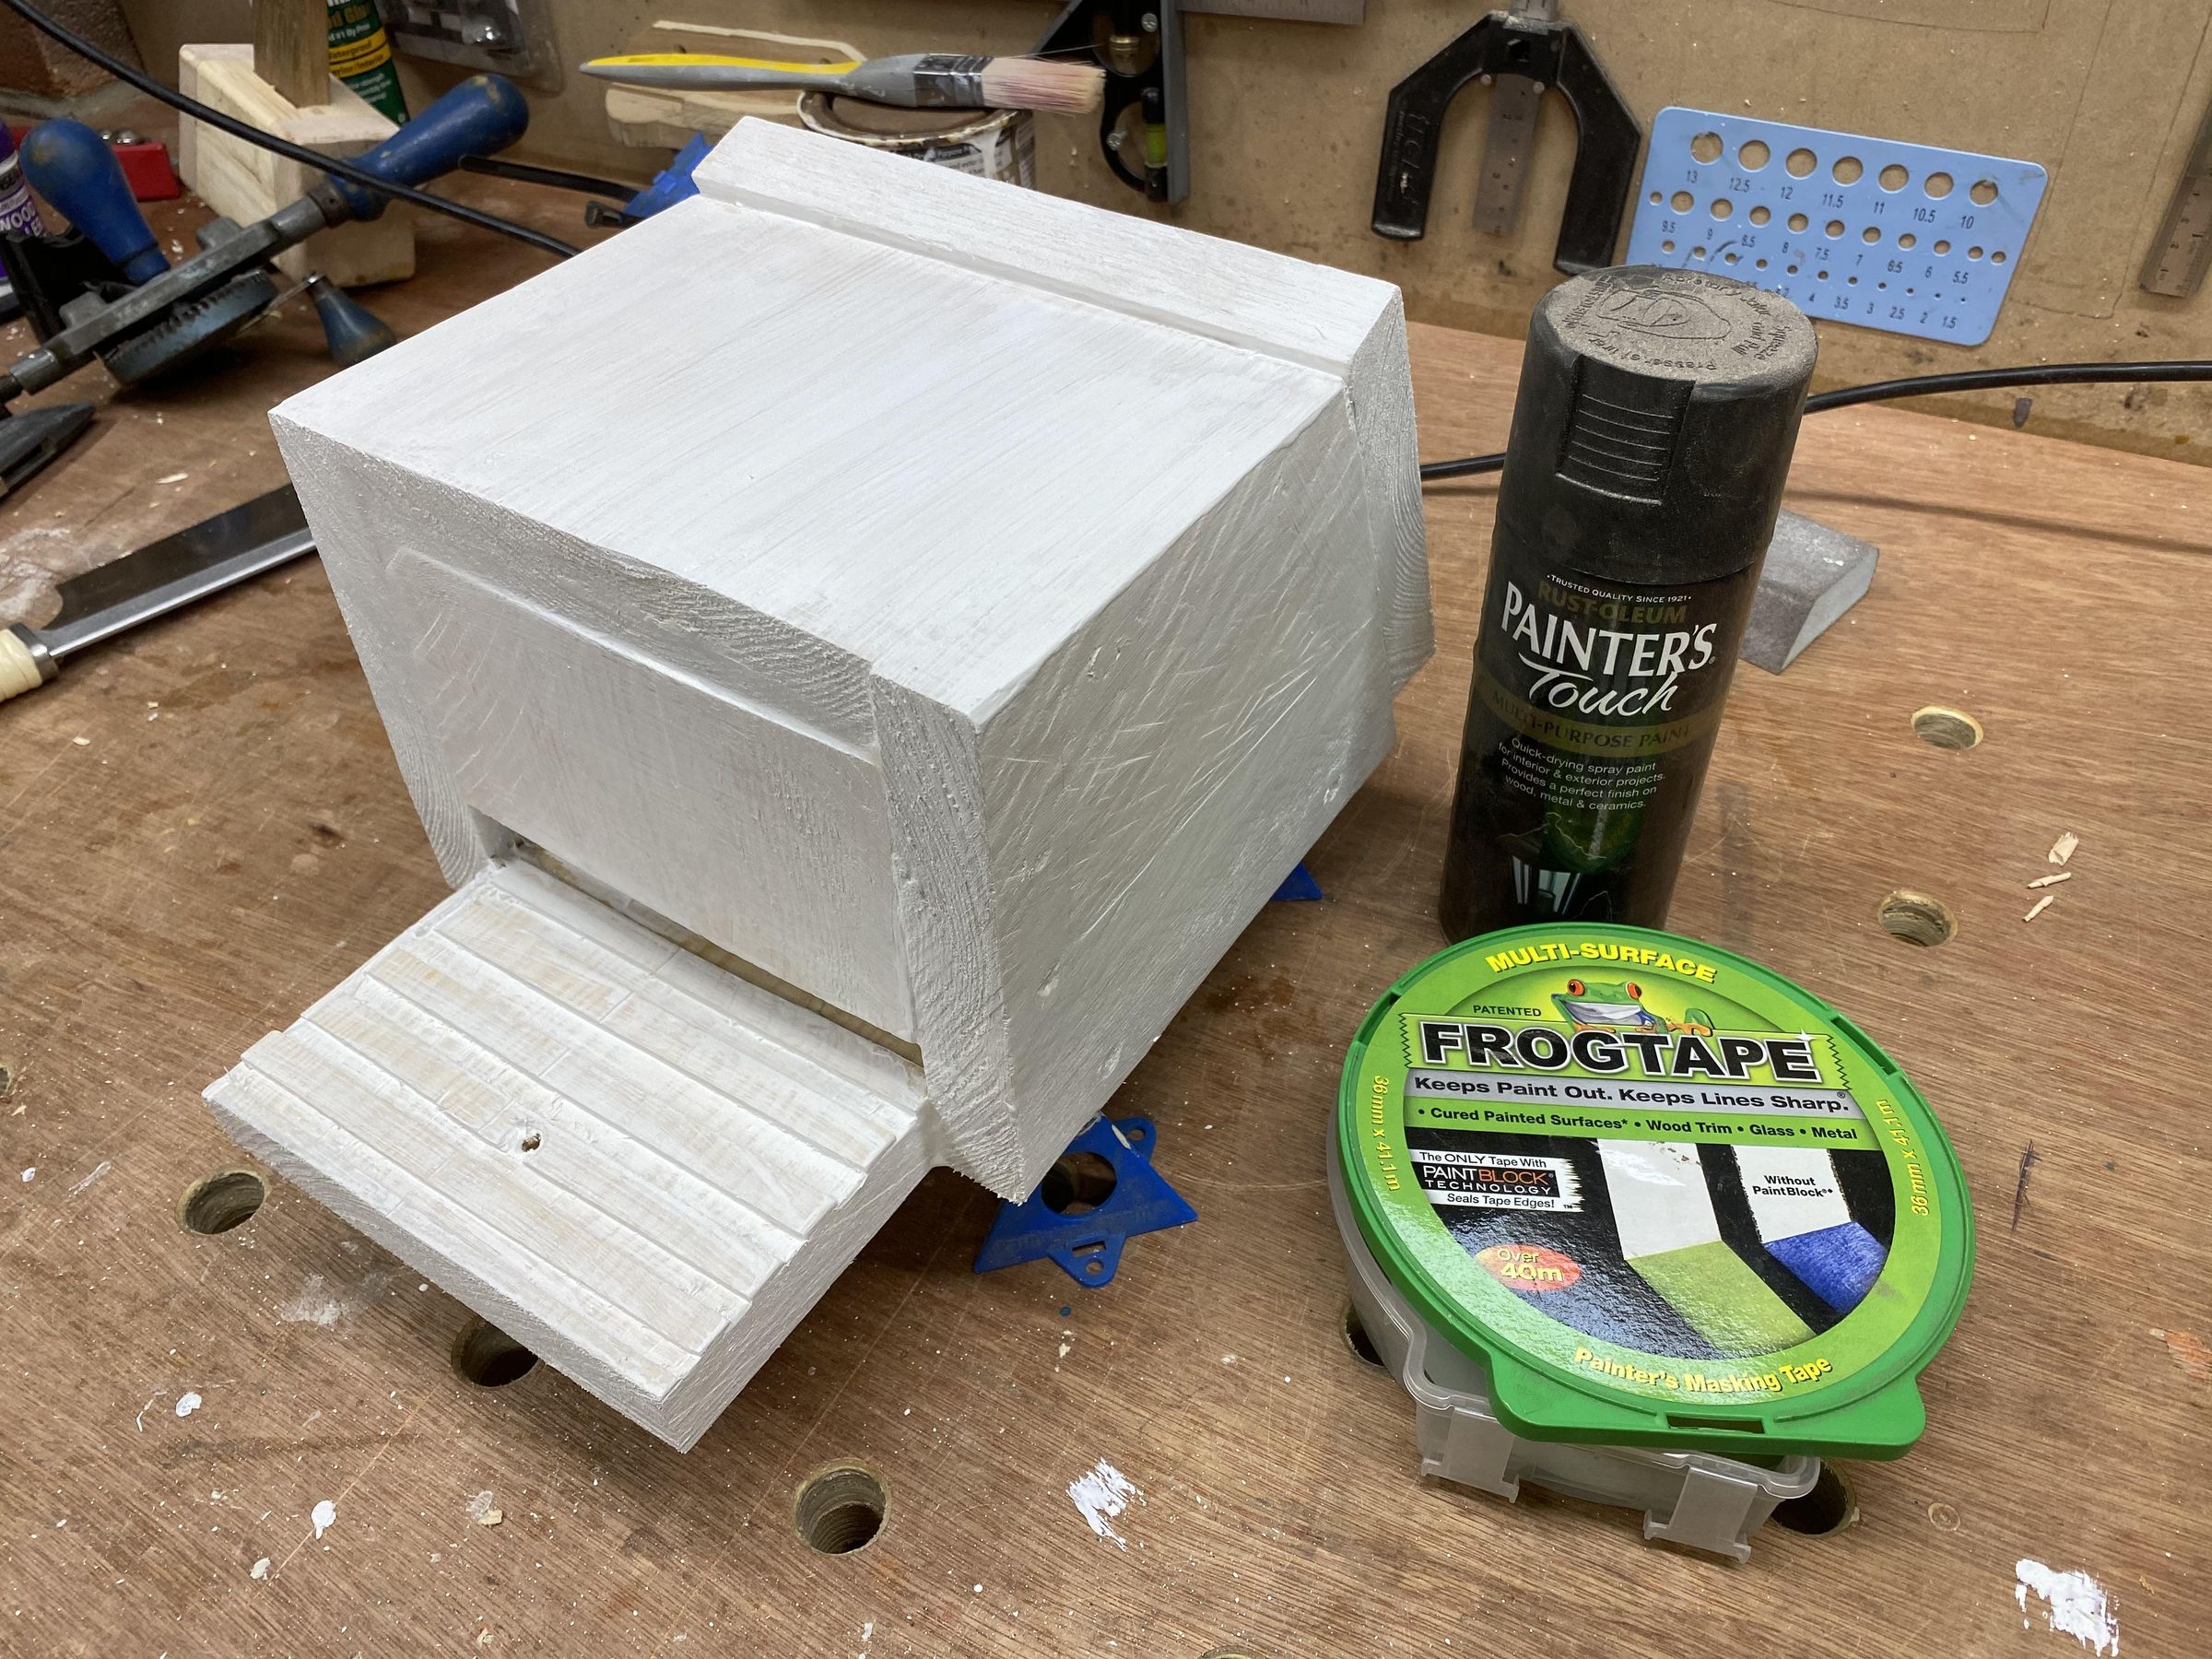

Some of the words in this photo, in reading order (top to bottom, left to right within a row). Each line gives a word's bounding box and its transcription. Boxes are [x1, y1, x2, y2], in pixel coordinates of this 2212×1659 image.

[1687, 170, 1698, 183] 13
[1730, 177, 1750, 193] 12.5
[1781, 186, 1794, 200] 12
[1822, 194, 1843, 208] 11.5
[1874, 202, 1886, 214] 11
[1913, 208, 1936, 223] 10.5
[1960, 216, 1974, 229] 10
[1662, 220, 1677, 233] 9.5
[1707, 229, 1713, 240] 9
[1741, 234, 1756, 248] 8.5
[1782, 241, 1789, 253] 8
[1815, 247, 1830, 261] 7.5
[1856, 254, 1863, 265] 7
[1888, 260, 1902, 273] 6.5
[1924, 266, 1933, 278] 6
[1952, 271, 1969, 284] 5.5
[1809, 293, 1816, 302] 4
[1834, 296, 1849, 310] 3.5
[1866, 302, 1874, 314] 3
[1889, 306, 1905, 320] 2.5
[1920, 312, 1928, 324] 2
[1942, 316, 1957, 329] 1.5
[1537, 580, 1688, 624] RUST-OLEUM
[1549, 574, 1590, 594] TRUSTED
[1592, 589, 1634, 602] QUALITY
[1501, 581, 1717, 677] PAINTER'S
[1518, 652, 1678, 716] Touch
[1491, 690, 1633, 747] MULTI-PURPOSE
[1639, 725, 1690, 747] PAINT
[1498, 741, 1512, 756] for
[1512, 749, 1550, 775] interior
[1553, 769, 1561, 779] &
[1565, 772, 1613, 787] exterior
[1512, 737, 1584, 773] Quick-drying
[1587, 764, 1624, 776] spray
[1626, 762, 1656, 775] paint
[1501, 758, 1547, 787] Provides
[1559, 784, 1604, 799] perfect
[1607, 789, 1639, 799] finish
[1642, 786, 1657, 796] on
[1540, 792, 1573, 807] metal
[1576, 799, 1585, 809] &
[1485, 942, 1717, 983] MULTI-SURFACE
[1473, 1005, 1542, 1017] PATENTED
[1419, 1020, 1823, 1084] FROGTAPE
[1371, 1075, 1389, 1124] 36mm
[1415, 1077, 1490, 1095] Keeps
[1497, 1082, 1557, 1097] Paint
[1564, 1085, 1613, 1100] Out.
[1619, 1088, 1695, 1106] Keeps
[1701, 1092, 1765, 1107] Lines
[1771, 1095, 1849, 1113] Sharp.
[1373, 1128, 1385, 1138] x
[1430, 1107, 1479, 1121] Cured
[1484, 1111, 1546, 1125] Painted
[1645, 1119, 1691, 1133] Wood
[1695, 1121, 1732, 1135] Trim
[1749, 1124, 1795, 1136] Glass
[1811, 1126, 1858, 1140] Metal
[1419, 1152, 1442, 1161] The
[1444, 1153, 1486, 1164] ONLY
[1488, 1156, 1518, 1168] Tape
[1519, 1158, 1547, 1168] With
[1901, 1148, 1916, 1159] x
[1425, 1180, 1551, 1195] TECHNOLOGY
[1764, 1175, 1817, 1186] Without
[1907, 1162, 1930, 1217] 36mm
[1447, 1193, 1480, 1205] Seals
[1482, 1195, 1512, 1207] Tape
[1513, 1197, 1555, 1209] Edges!
[1498, 1248, 1540, 1263] Over
[1500, 1263, 1564, 1282] 40m
[1573, 1347, 1679, 1391] Painter's
[1684, 1371, 1783, 1393] Masking
[1779, 1357, 1833, 1383] Tape
